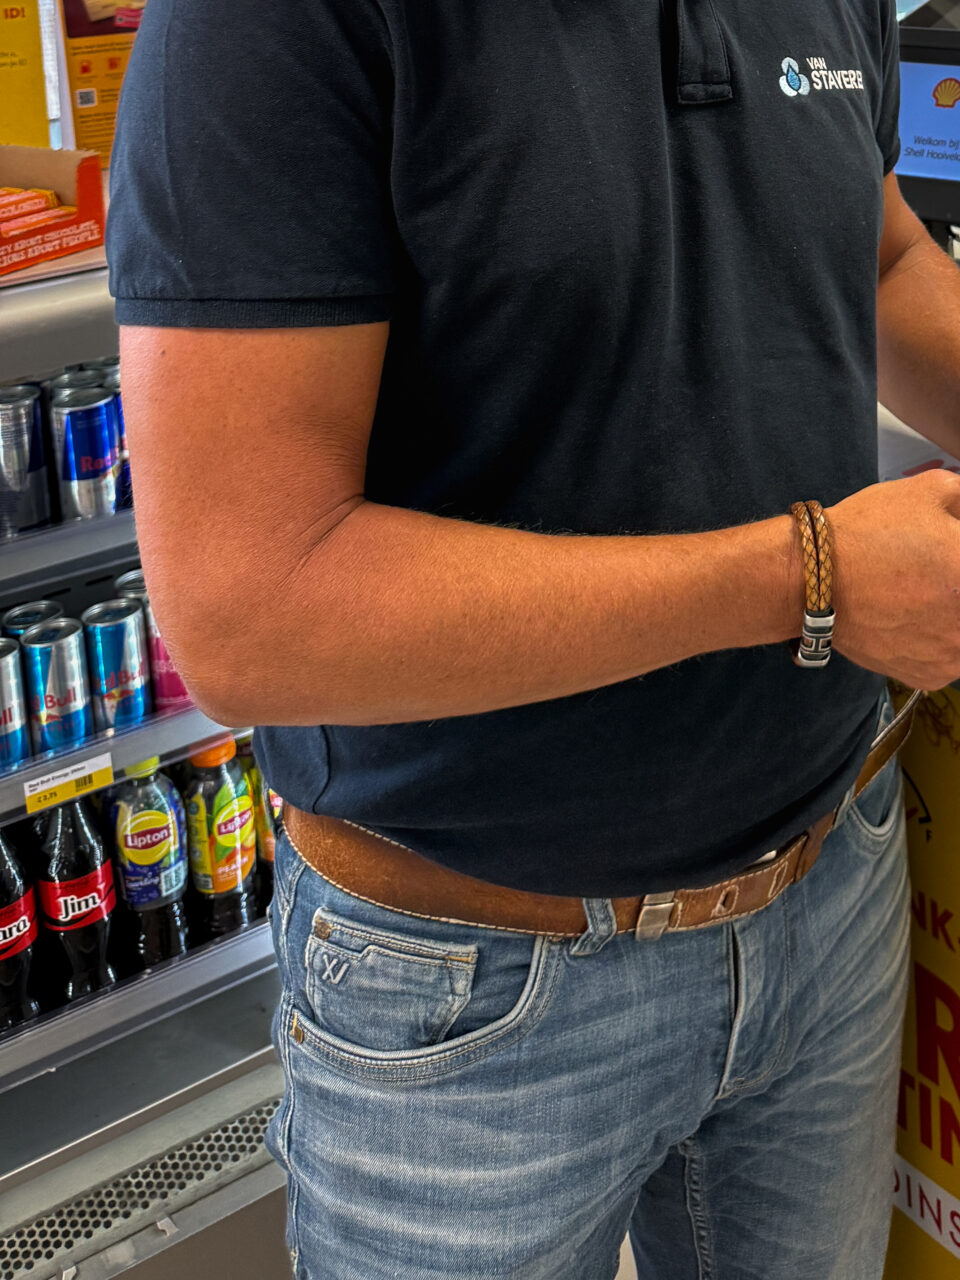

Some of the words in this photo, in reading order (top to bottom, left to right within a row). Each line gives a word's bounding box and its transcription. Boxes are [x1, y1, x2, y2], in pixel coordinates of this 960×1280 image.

[4, 7, 26, 19] ID!
[806, 56, 828, 70] VAN
[914, 136, 946, 147] Welkom
[949, 138, 960, 150] bij
[904, 146, 925, 157] Shell
[14, 233, 44, 249] ABOUT
[28, 240, 61, 258] ABOUT
[45, 687, 77, 710] Bull
[126, 829, 169, 848] Lipton
[60, 893, 99, 920] Jim
